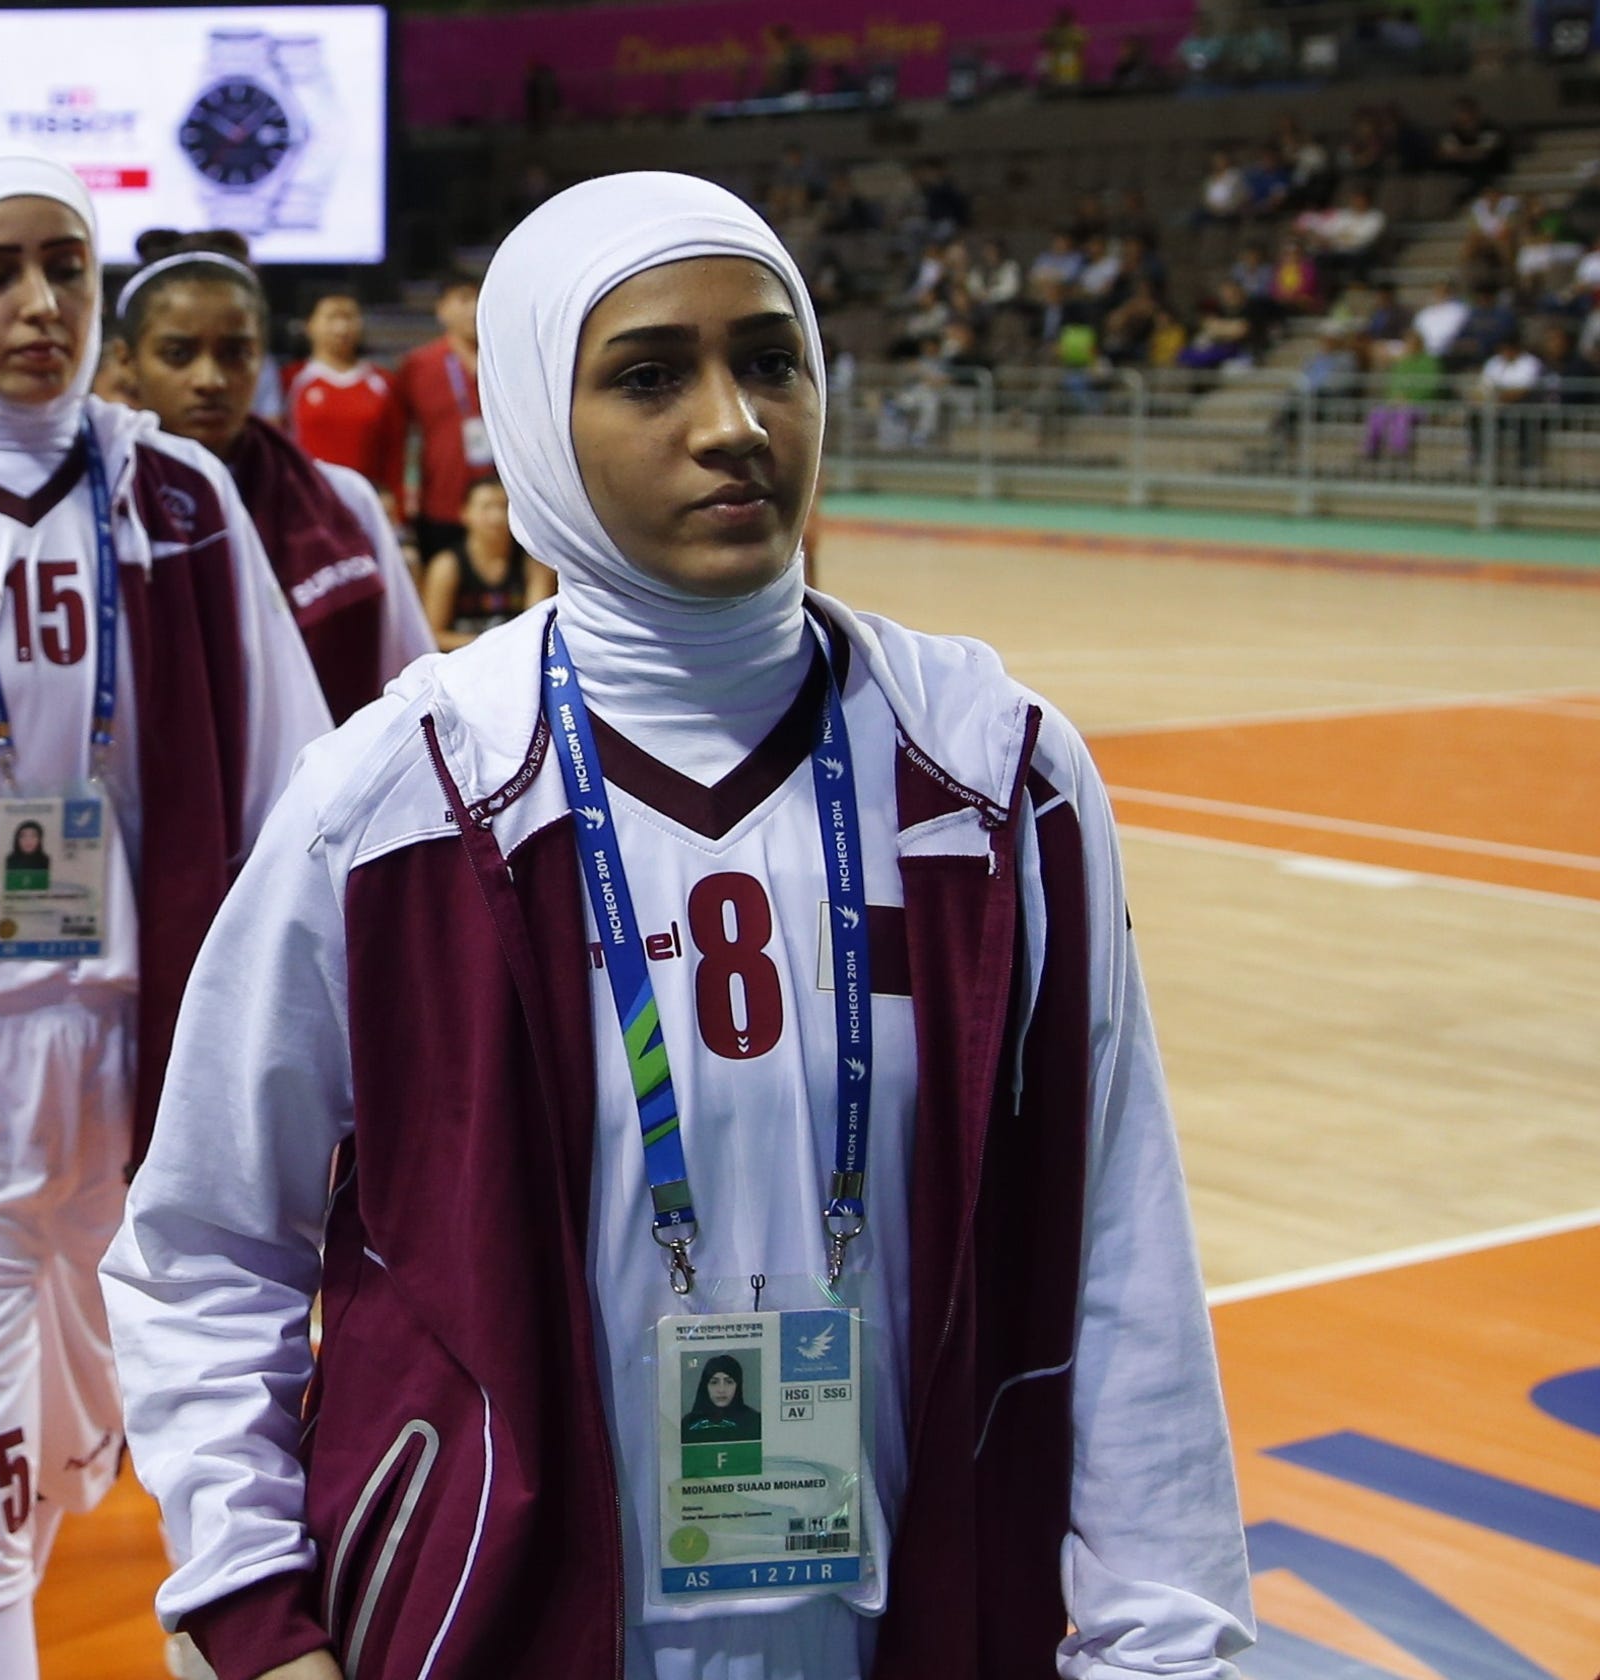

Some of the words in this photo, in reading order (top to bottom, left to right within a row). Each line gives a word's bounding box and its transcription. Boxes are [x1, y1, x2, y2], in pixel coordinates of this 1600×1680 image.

[5, 557, 88, 666] 15
[559, 703, 576, 732] 2014
[567, 734, 591, 793] INCHEON
[906, 747, 946, 785] BURRDA
[836, 800, 850, 829] 2014
[593, 850, 610, 879] 2014
[837, 831, 853, 892] INCHEON
[601, 880, 625, 945] INCHEON
[687, 871, 784, 1060] 8
[846, 950, 860, 981] 2014
[848, 982, 861, 1044] INCHEON
[848, 1102, 859, 1130] 2014
[785, 1389, 809, 1400] HSG
[823, 1387, 846, 1399] SSG
[788, 1407, 805, 1418] AV
[717, 1452, 727, 1469] F
[682, 1485, 735, 1495] MOHAMED
[736, 1482, 771, 1492] SUAAD
[773, 1479, 826, 1490] MOHAMED
[685, 1572, 710, 1588] AS
